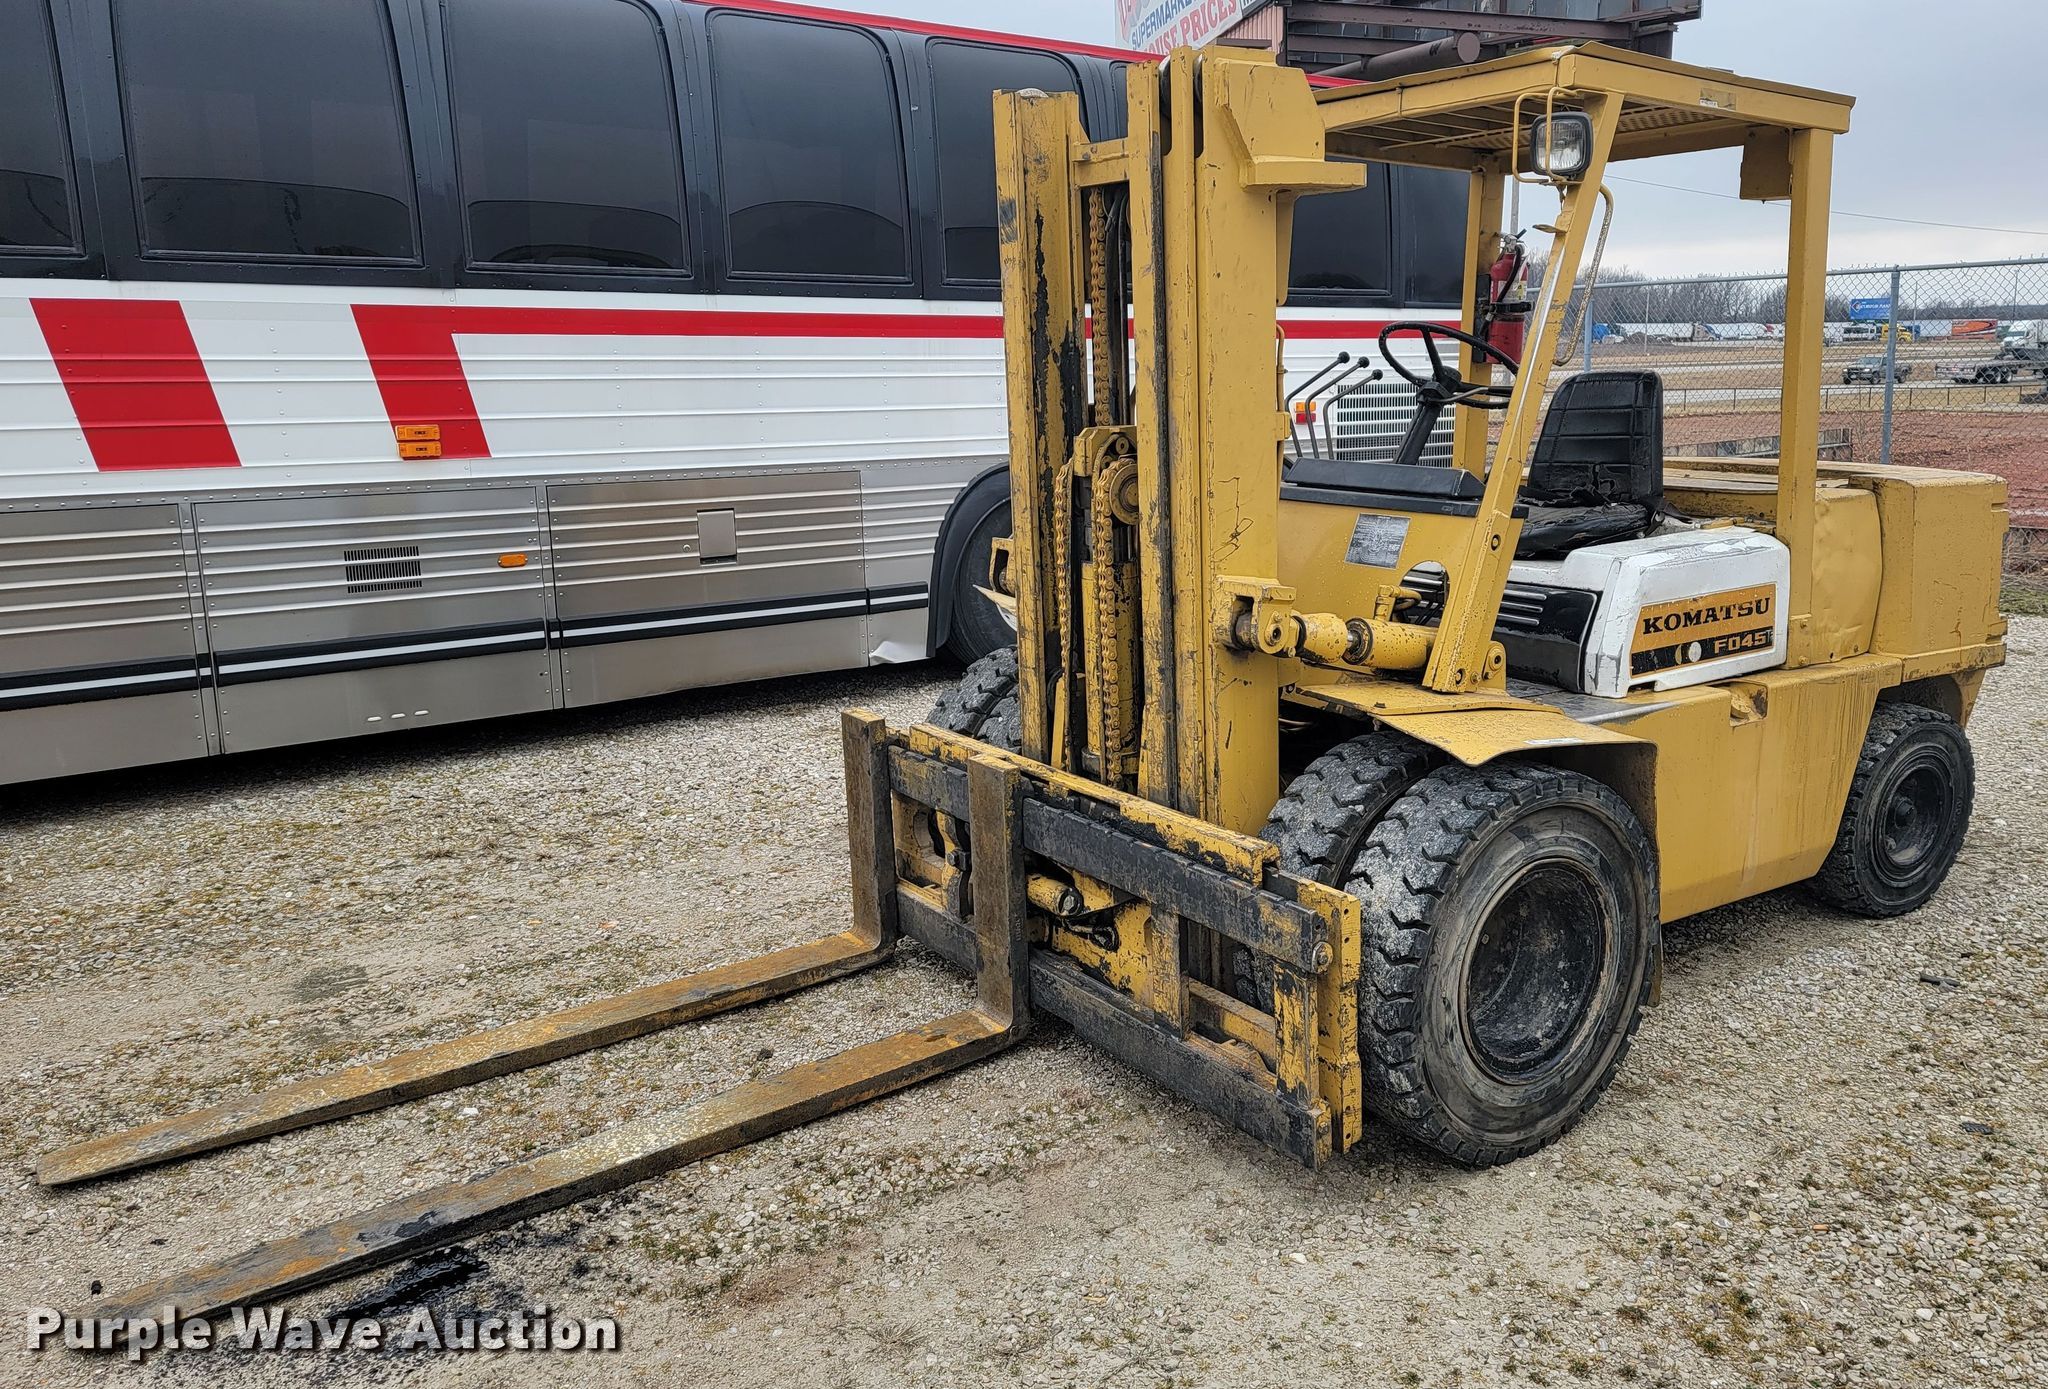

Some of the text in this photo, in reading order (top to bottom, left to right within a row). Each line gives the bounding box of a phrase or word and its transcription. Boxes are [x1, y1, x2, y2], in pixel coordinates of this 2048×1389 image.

[1144, 25, 1178, 54] OUSE
[1180, 0, 1237, 46] PRICES
[1642, 597, 1771, 635] KOMATSU
